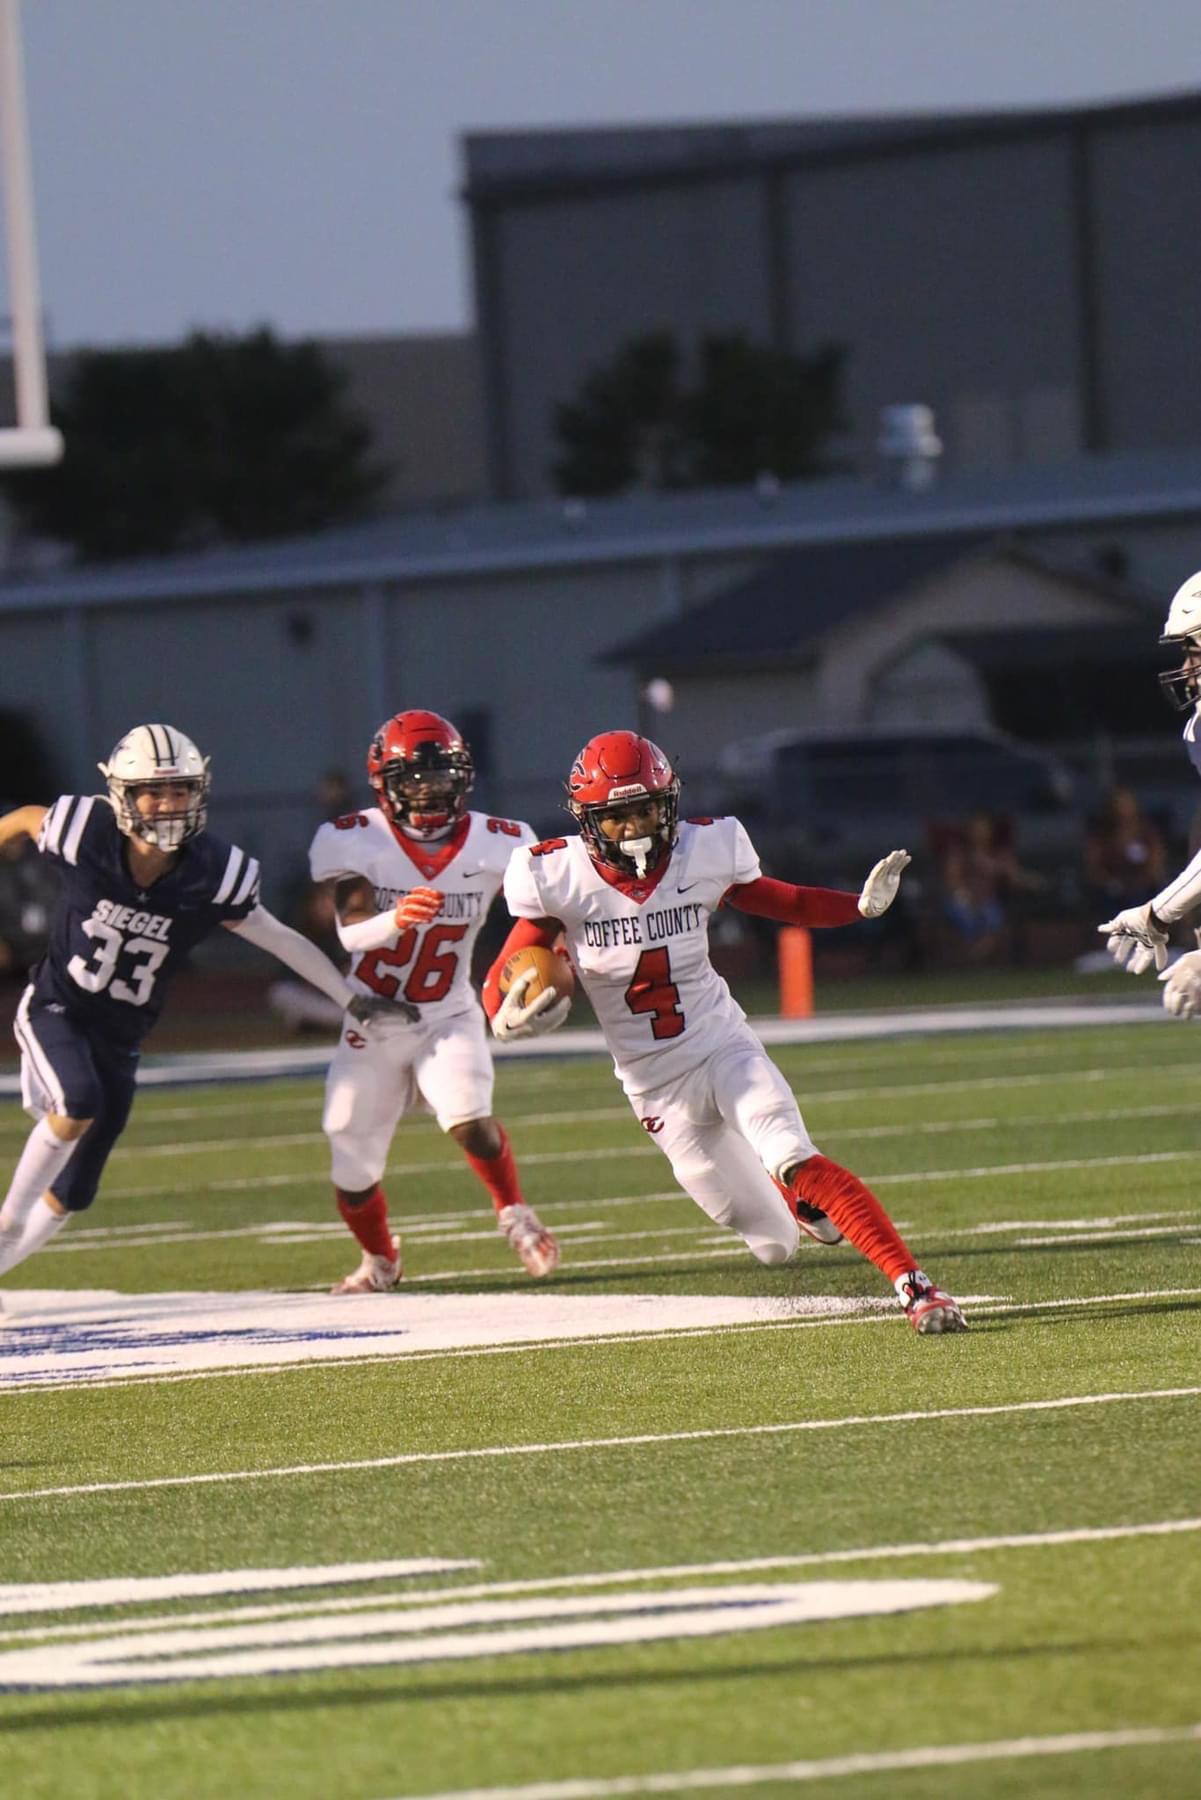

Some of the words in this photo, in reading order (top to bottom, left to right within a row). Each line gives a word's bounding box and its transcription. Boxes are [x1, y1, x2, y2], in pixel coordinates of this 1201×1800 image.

[92, 899, 173, 941] SIEGEL
[584, 916, 643, 948] COFFEE
[646, 903, 703, 941] COUNTY
[67, 918, 170, 1006] 33
[354, 924, 469, 1004] 26
[624, 945, 686, 1040] 4
